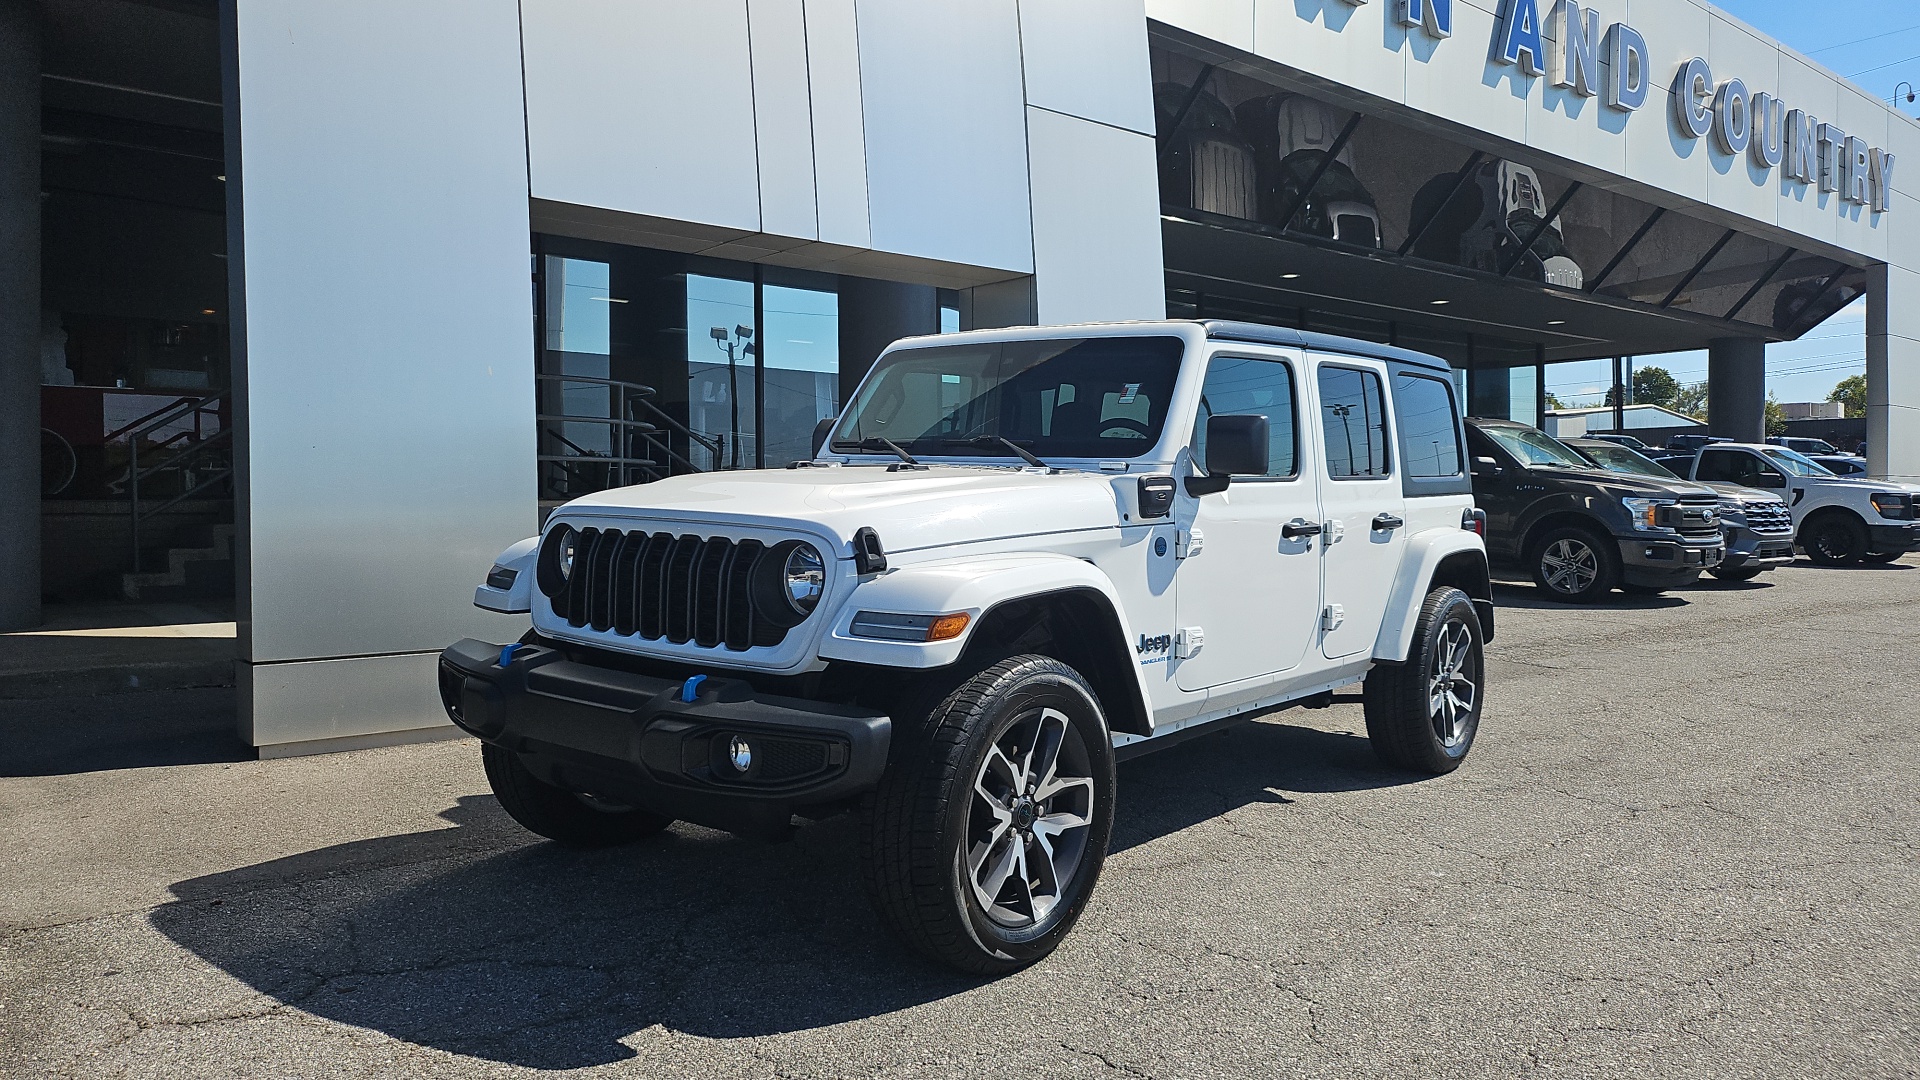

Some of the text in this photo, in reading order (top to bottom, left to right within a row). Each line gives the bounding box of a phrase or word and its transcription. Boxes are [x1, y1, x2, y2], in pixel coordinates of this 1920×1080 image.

[1496, 0, 1896, 213] AND COUNTRY
[1135, 633, 1171, 653] Jeep
